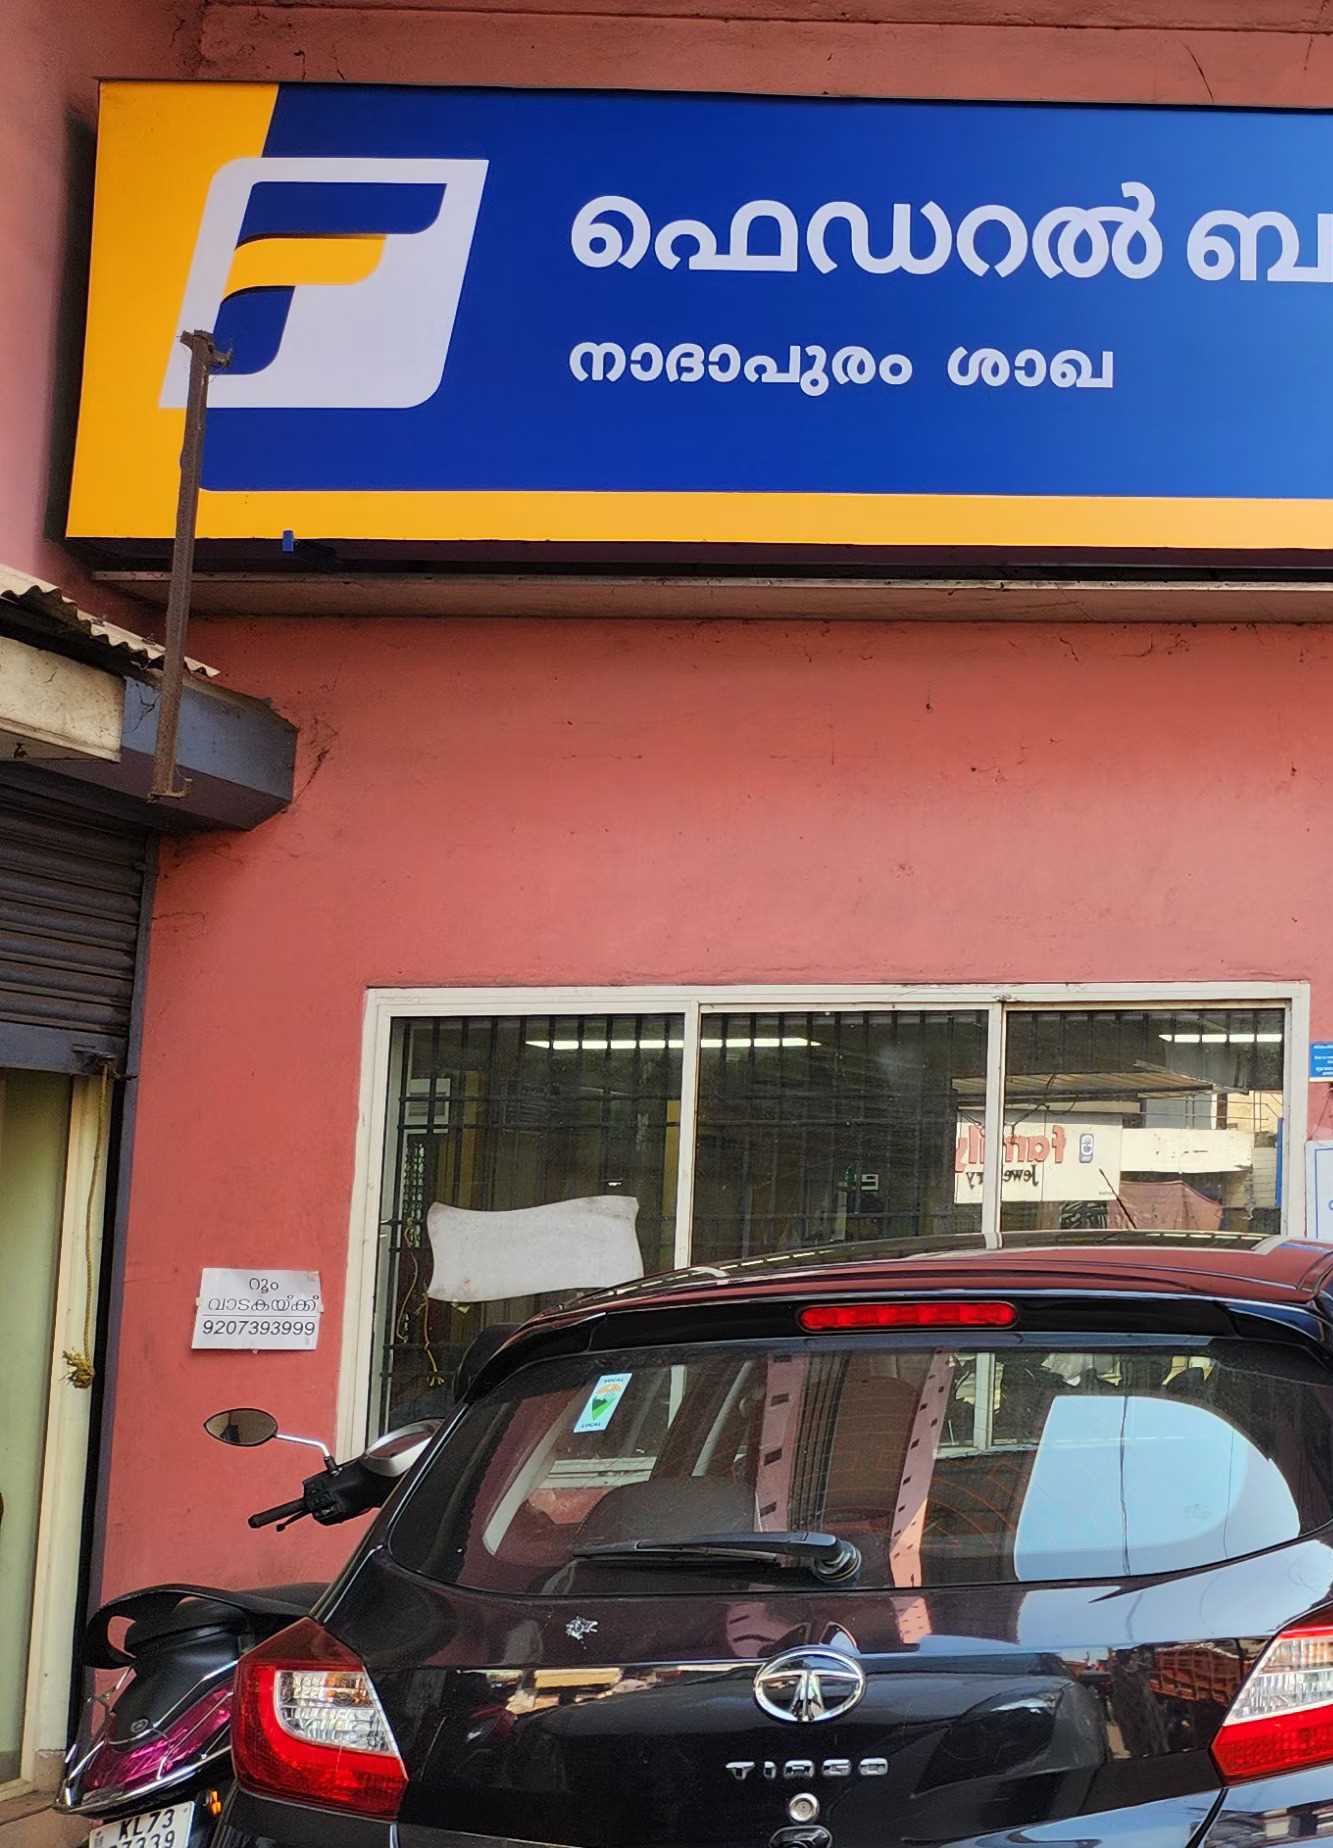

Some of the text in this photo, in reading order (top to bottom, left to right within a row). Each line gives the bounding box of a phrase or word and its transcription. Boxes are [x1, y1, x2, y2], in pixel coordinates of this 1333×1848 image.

[571, 182, 1163, 278] ഫെഡറൽ
[569, 342, 1114, 396] നാദാപുരം ശാഖ
[249, 1277, 279, 1295] റൂം
[202, 1320, 316, 1336] 9207393999
[725, 1757, 889, 1780] TIAGO
